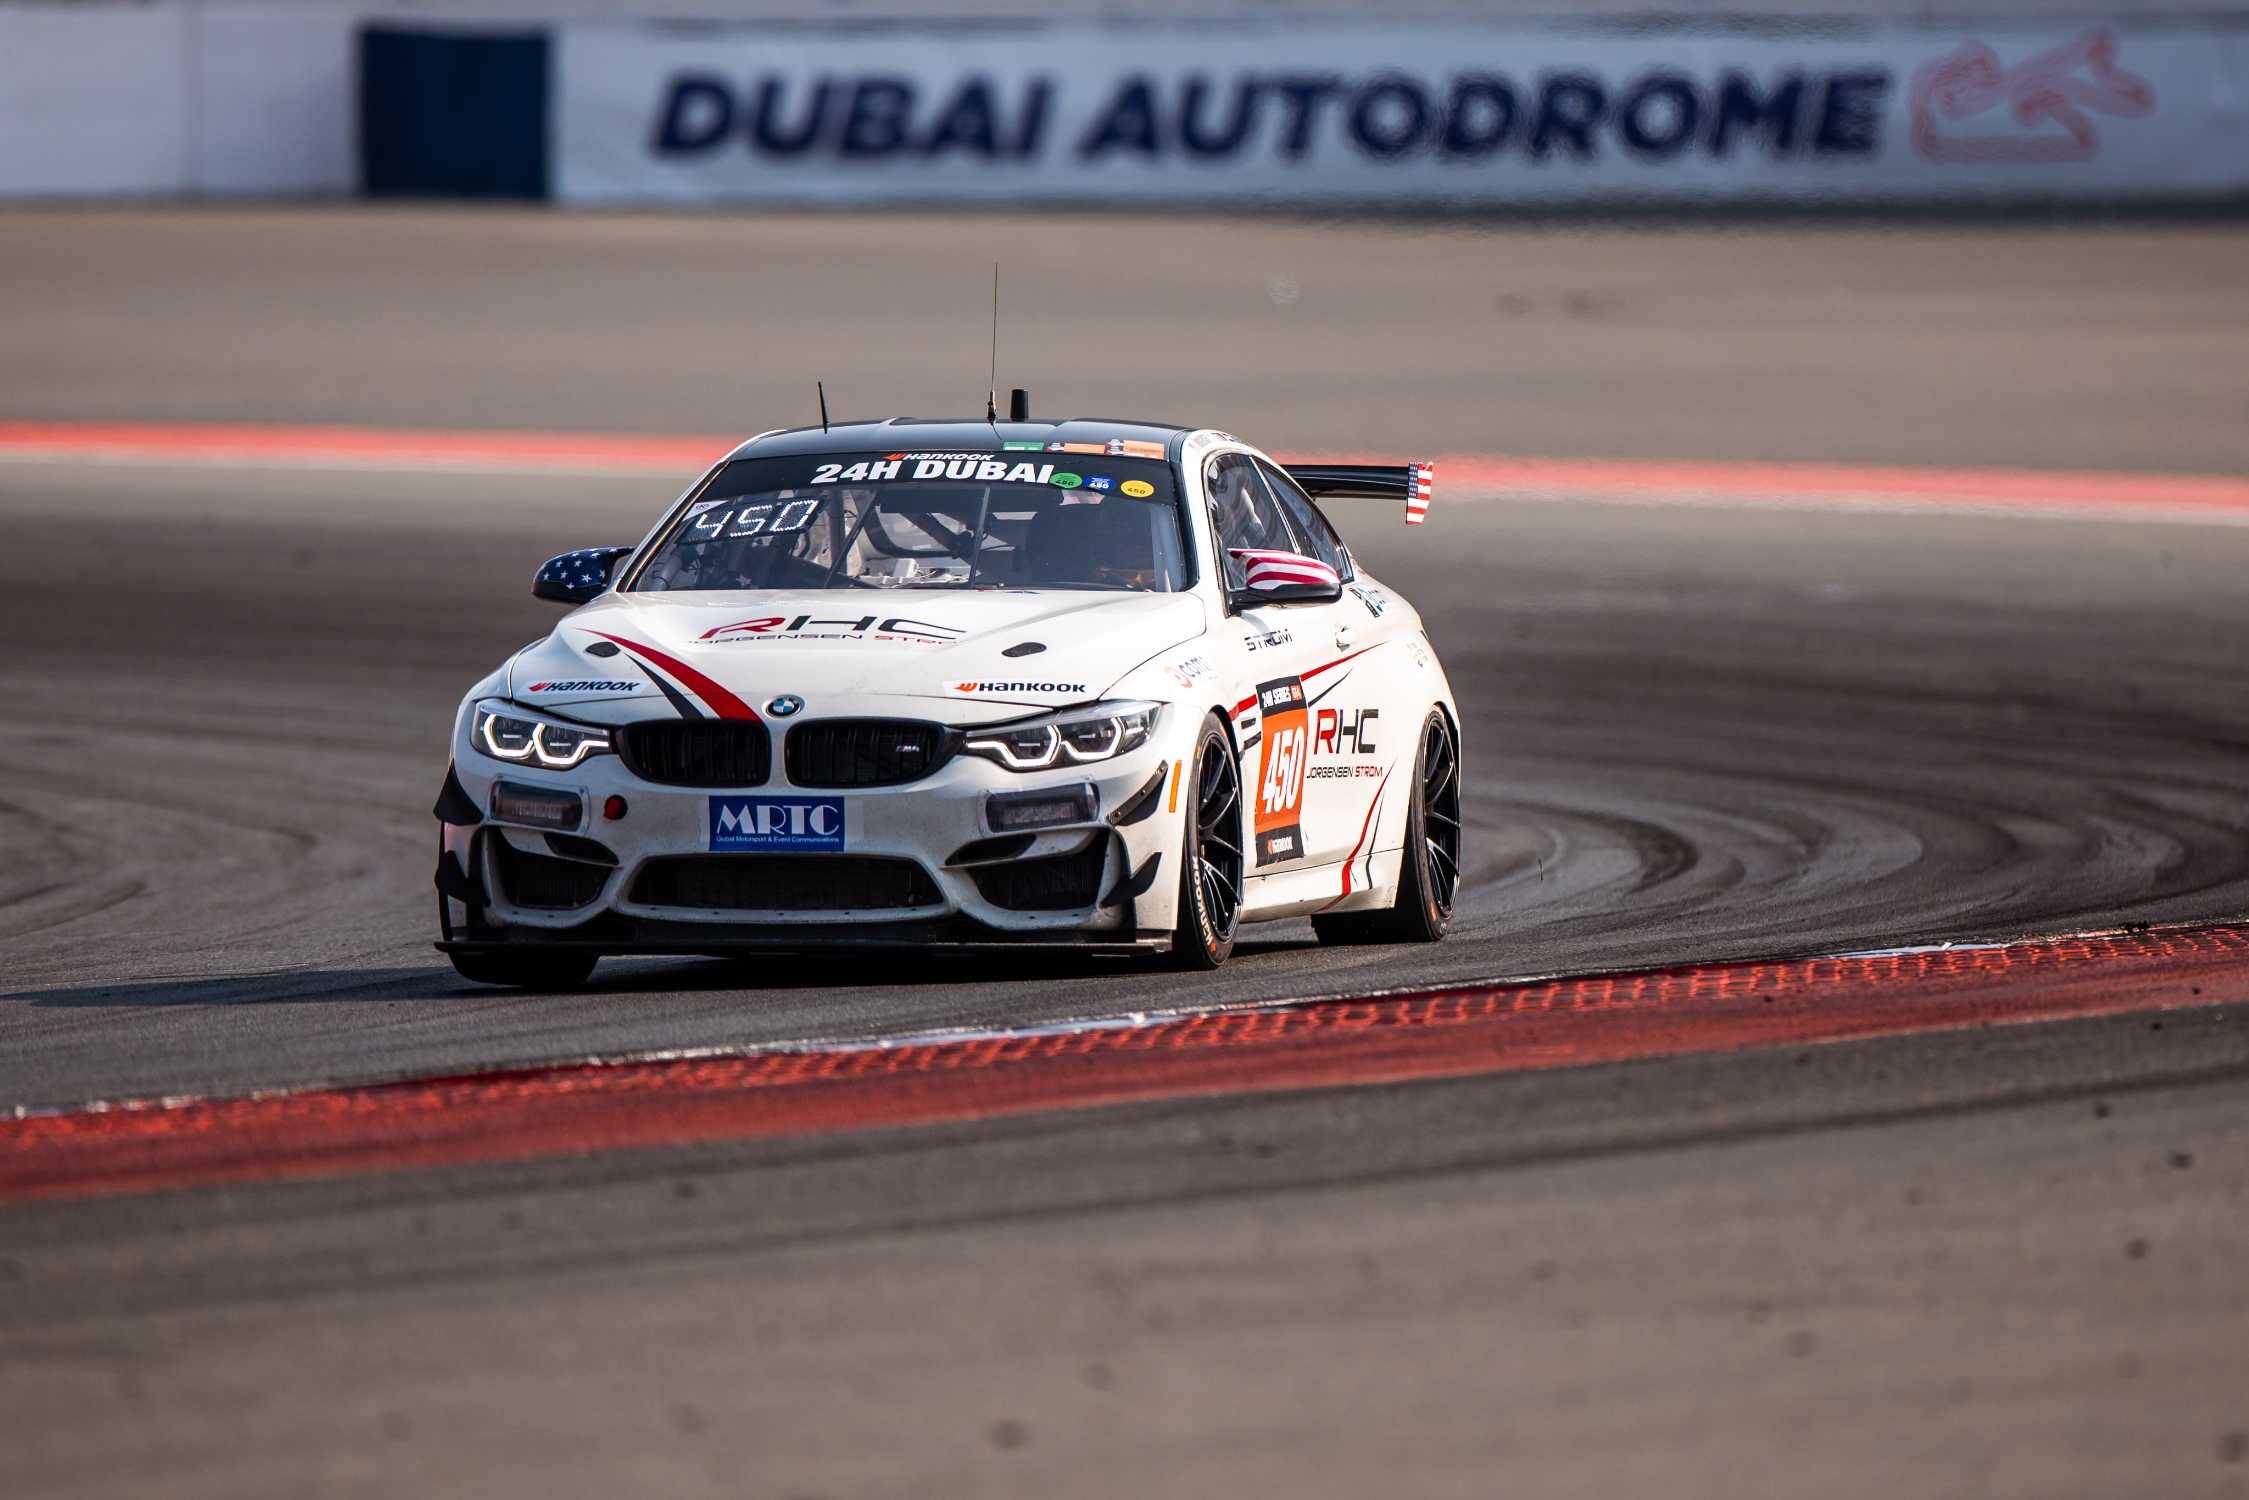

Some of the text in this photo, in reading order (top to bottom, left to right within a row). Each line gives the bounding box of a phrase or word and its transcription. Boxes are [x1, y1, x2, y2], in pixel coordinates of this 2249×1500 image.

[650, 70, 1890, 162] DUBAI AUTODROME
[810, 459, 1055, 485] 24H DUBAI
[695, 499, 819, 538] 450
[697, 615, 968, 641] RHC
[1313, 708, 1379, 755] RHC
[1261, 725, 1305, 815] 450
[1306, 766, 1383, 779] JORGENSEN STROM
[716, 803, 840, 836] MRTC
